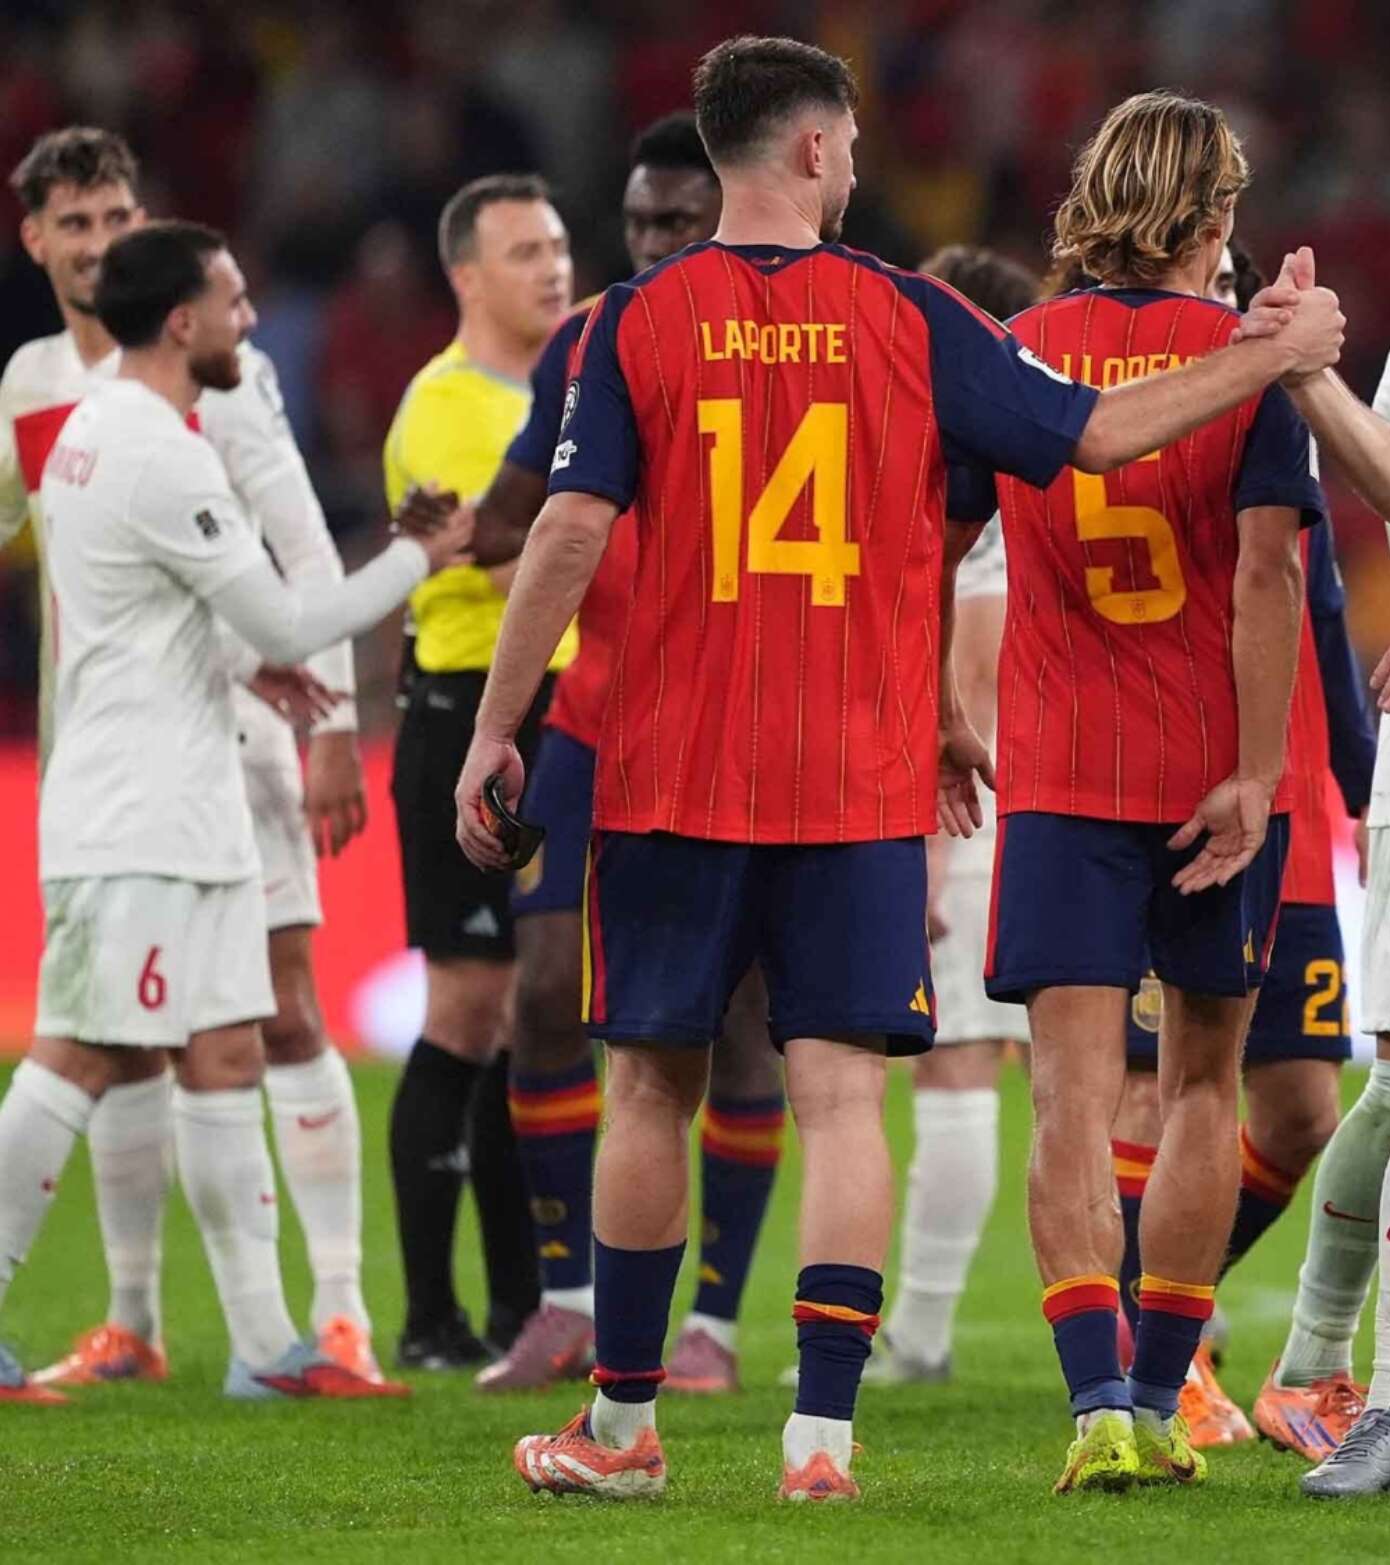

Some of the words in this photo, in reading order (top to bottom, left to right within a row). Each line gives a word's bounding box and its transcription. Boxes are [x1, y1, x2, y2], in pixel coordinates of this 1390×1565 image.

[700, 319, 847, 365] LAPORTE
[697, 398, 860, 607] 14
[1072, 450, 1187, 625] 5
[138, 946, 168, 1010] 6
[1303, 959, 1351, 1036] 2
